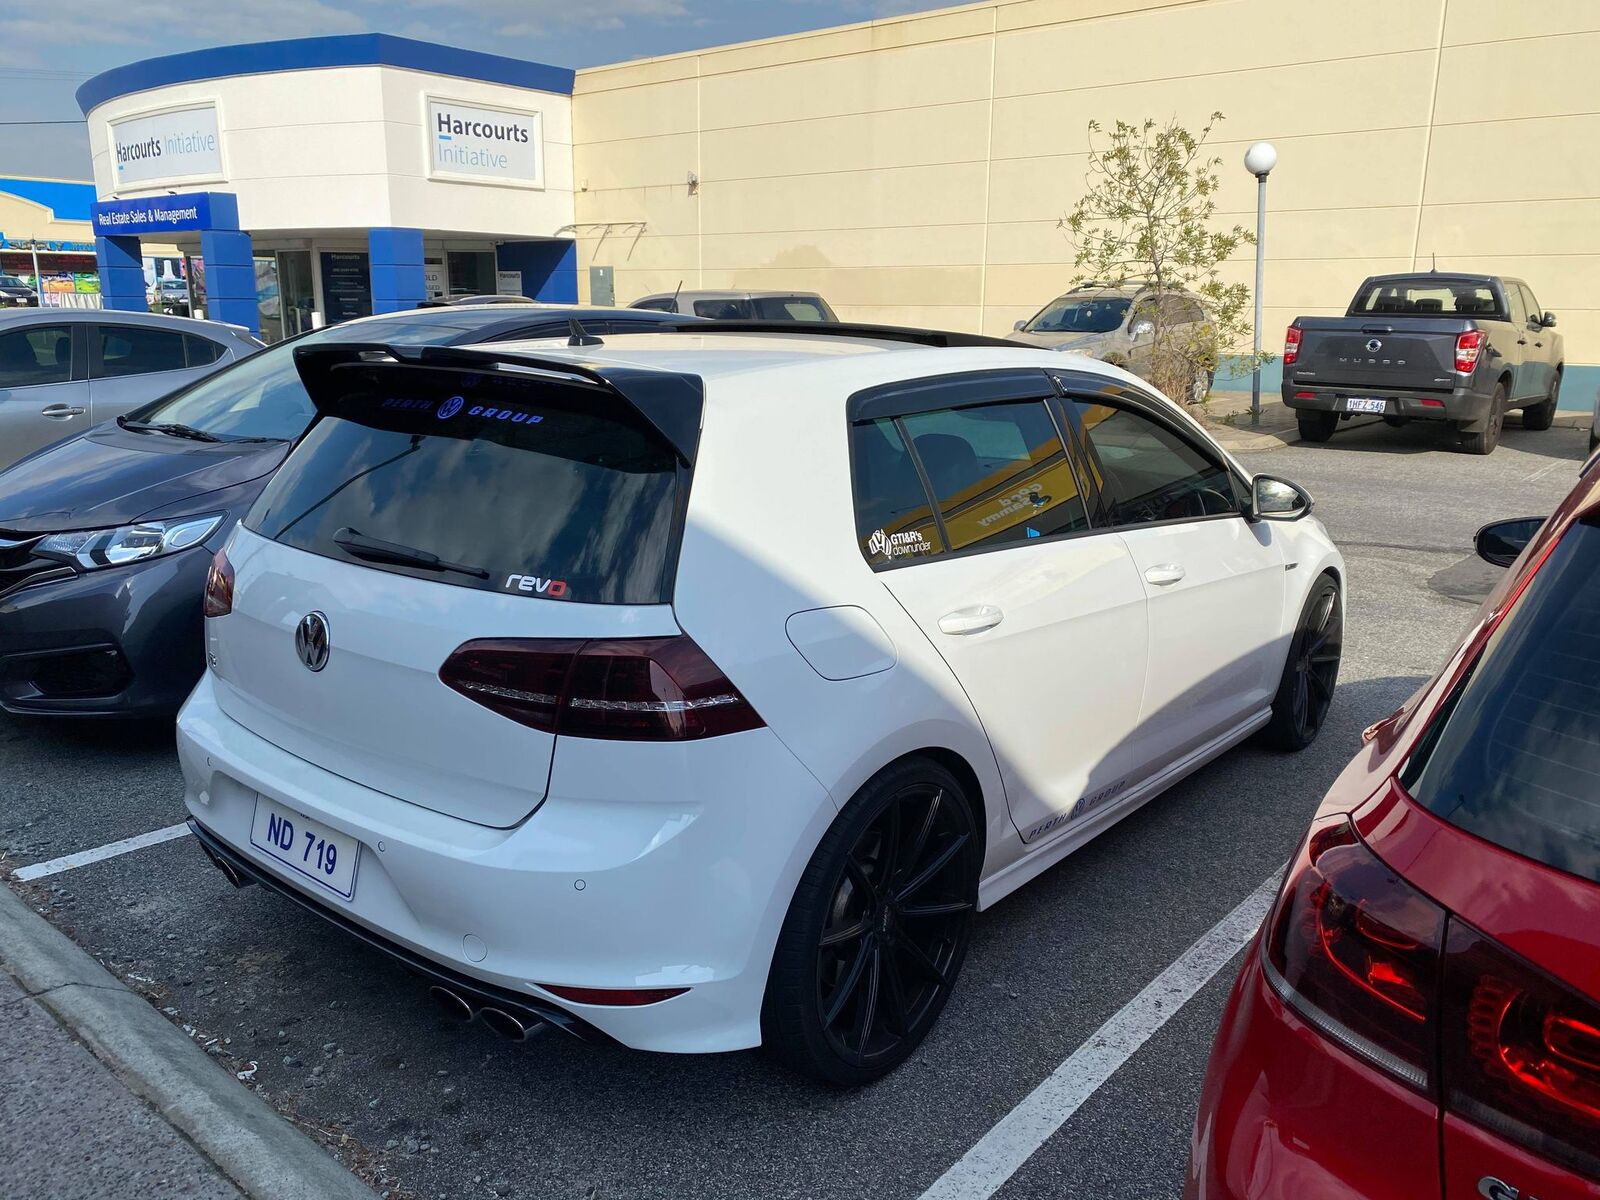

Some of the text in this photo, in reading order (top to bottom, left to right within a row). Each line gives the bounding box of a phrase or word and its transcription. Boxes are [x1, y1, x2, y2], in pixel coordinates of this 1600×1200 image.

[437, 112, 529, 143] Harcourts
[115, 131, 215, 163] Harcourts Initiative
[438, 144, 508, 168] Initiative
[98, 206, 198, 225] Real Estate Sales & Management
[468, 405, 545, 425] GROUP
[505, 573, 567, 597] revo
[267, 813, 337, 875] ND 719
